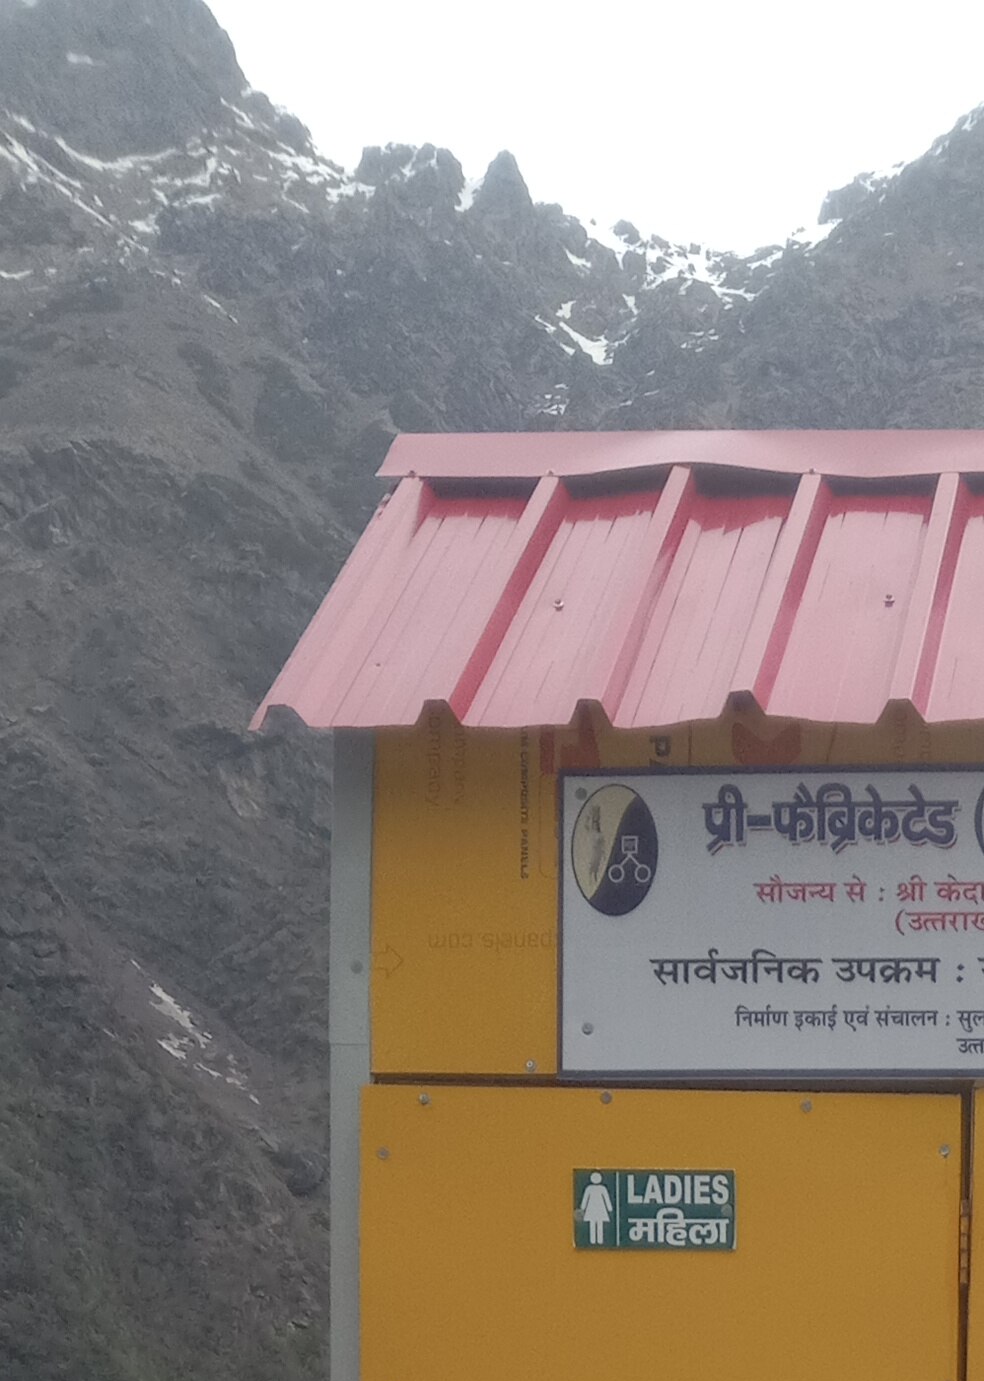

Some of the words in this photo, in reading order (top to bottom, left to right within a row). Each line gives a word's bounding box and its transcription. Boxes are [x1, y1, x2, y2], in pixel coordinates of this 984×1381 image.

[753, 874, 836, 903] सौजन्य
[844, 874, 867, 902] से
[896, 875, 927, 902] श्री
[650, 948, 822, 985] सार्वजनिक
[832, 958, 940, 983] उपक्रम
[735, 1005, 788, 1027] निर्माण
[793, 1005, 838, 1031] इकाई
[843, 1005, 869, 1031] एवं
[874, 1005, 939, 1027] संचालन
[627, 1174, 730, 1205] LADIES
[628, 1207, 730, 1246] महिला
